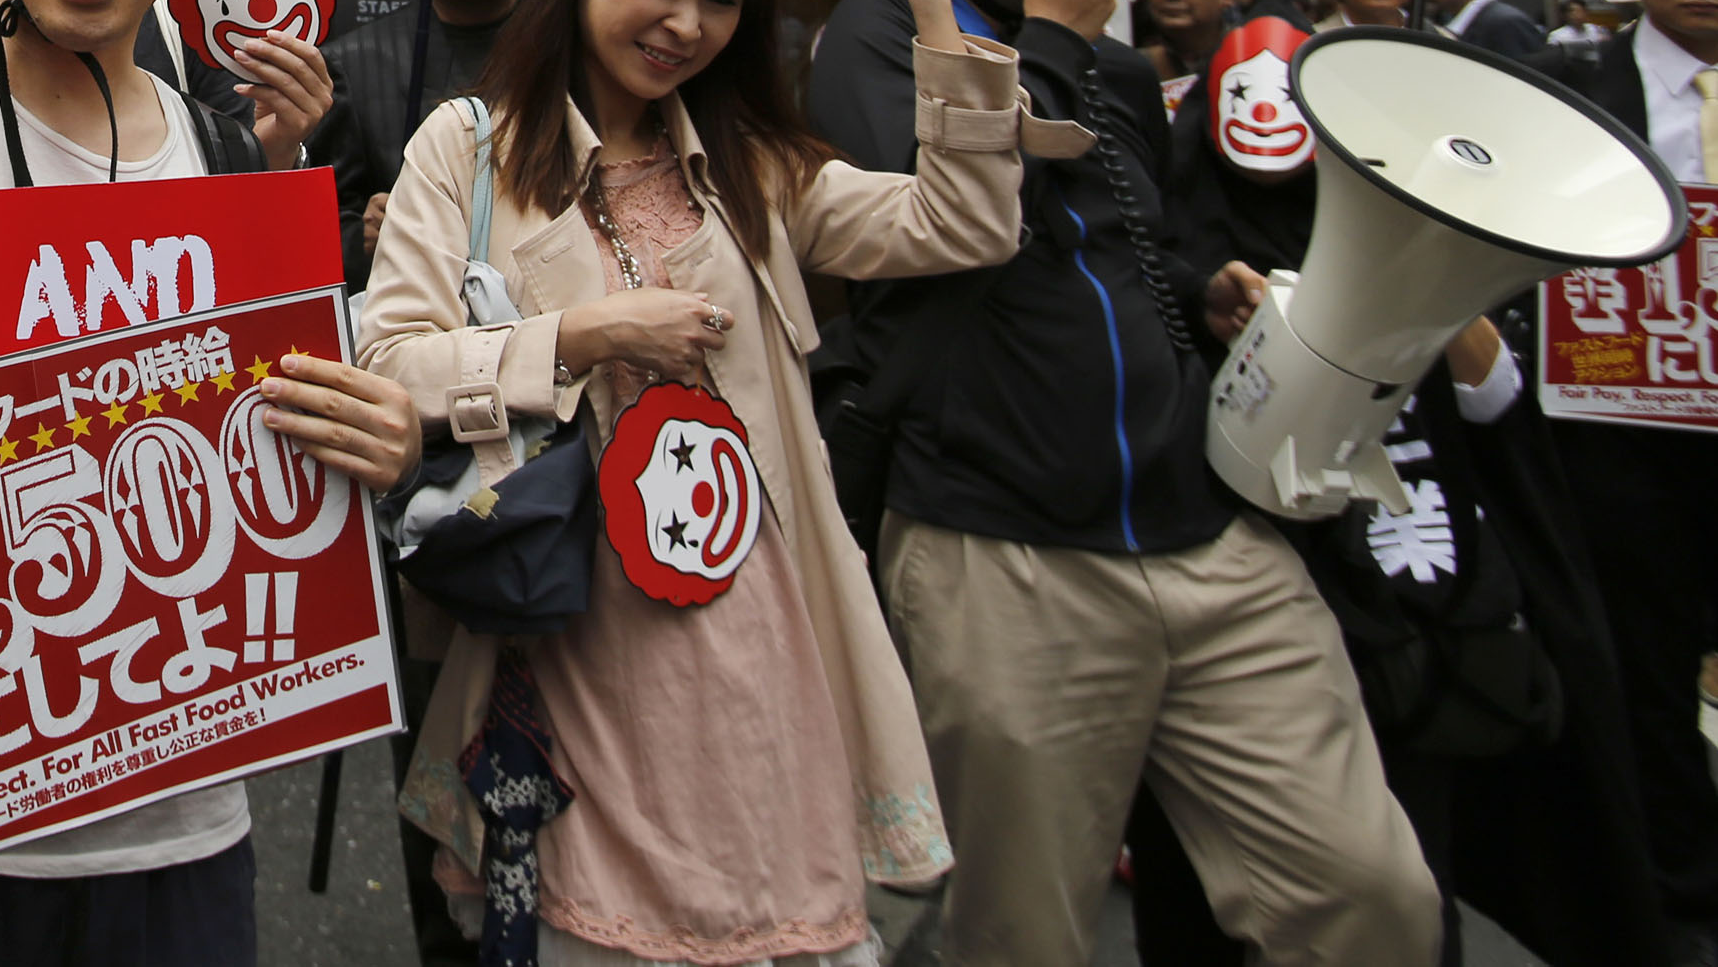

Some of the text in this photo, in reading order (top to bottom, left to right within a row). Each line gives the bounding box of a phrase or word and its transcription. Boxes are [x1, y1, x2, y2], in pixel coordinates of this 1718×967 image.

[16, 234, 218, 341] AND
[42, 752, 83, 780] For
[91, 730, 122, 763] All
[131, 713, 179, 747] Fast
[185, 685, 246, 726] Food
[250, 653, 365, 700] Workers.
